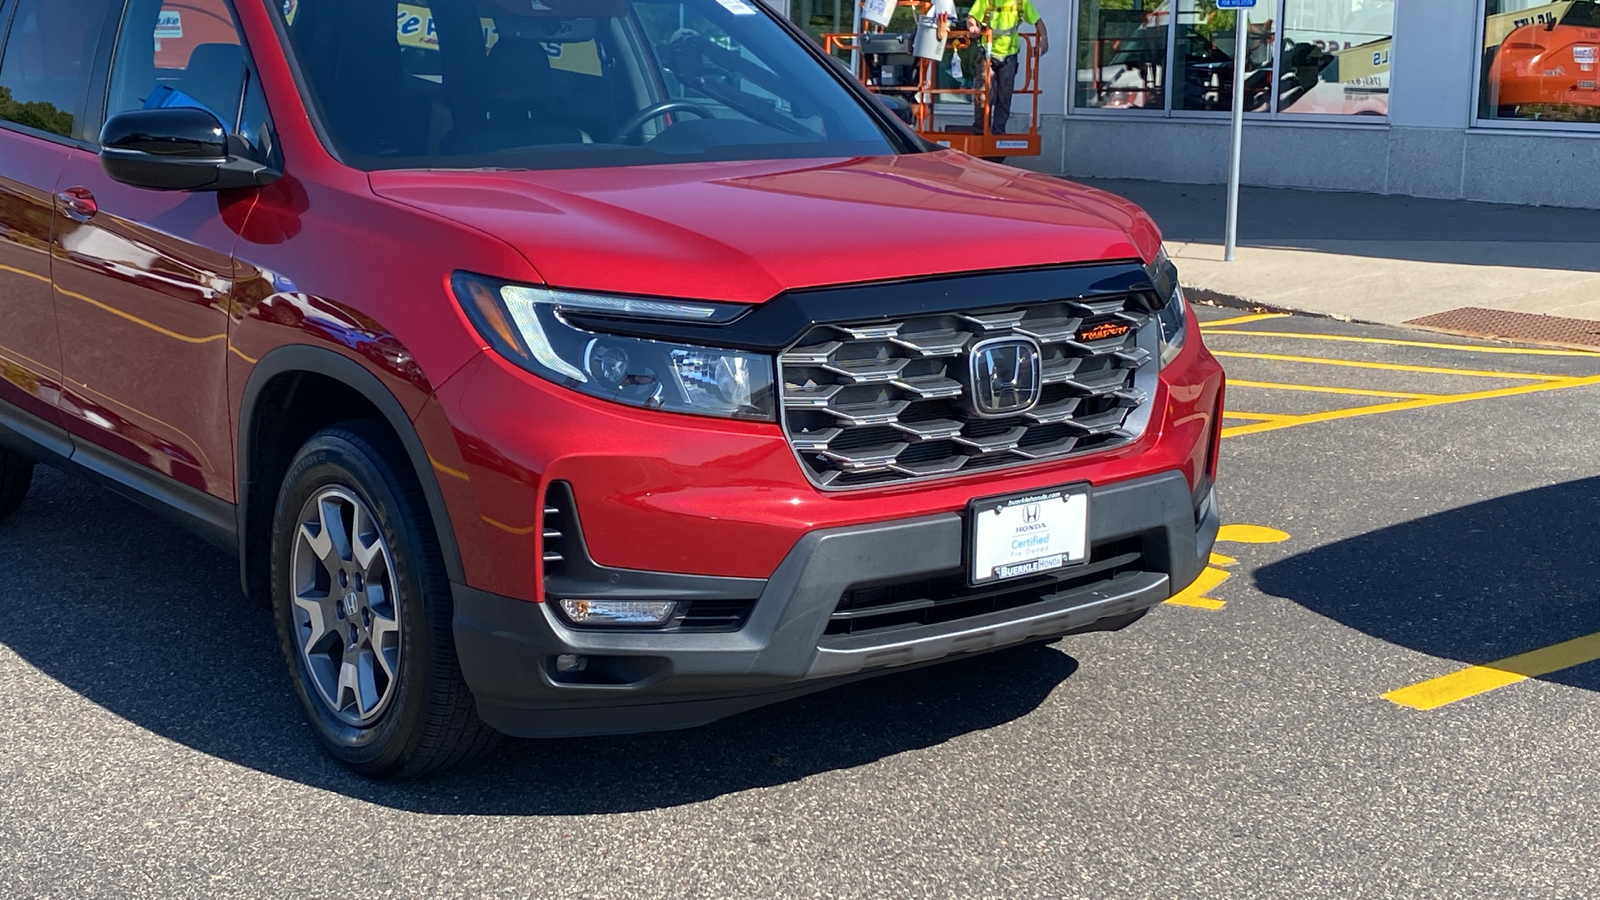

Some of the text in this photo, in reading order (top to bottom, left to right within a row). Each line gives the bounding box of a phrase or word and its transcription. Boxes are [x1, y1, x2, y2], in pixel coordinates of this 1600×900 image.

[1015, 522, 1047, 533] HONDA
[1011, 533, 1050, 550] Certified
[1025, 546, 1049, 555] Owned
[1001, 558, 1061, 577] BUERKLE HONDA
